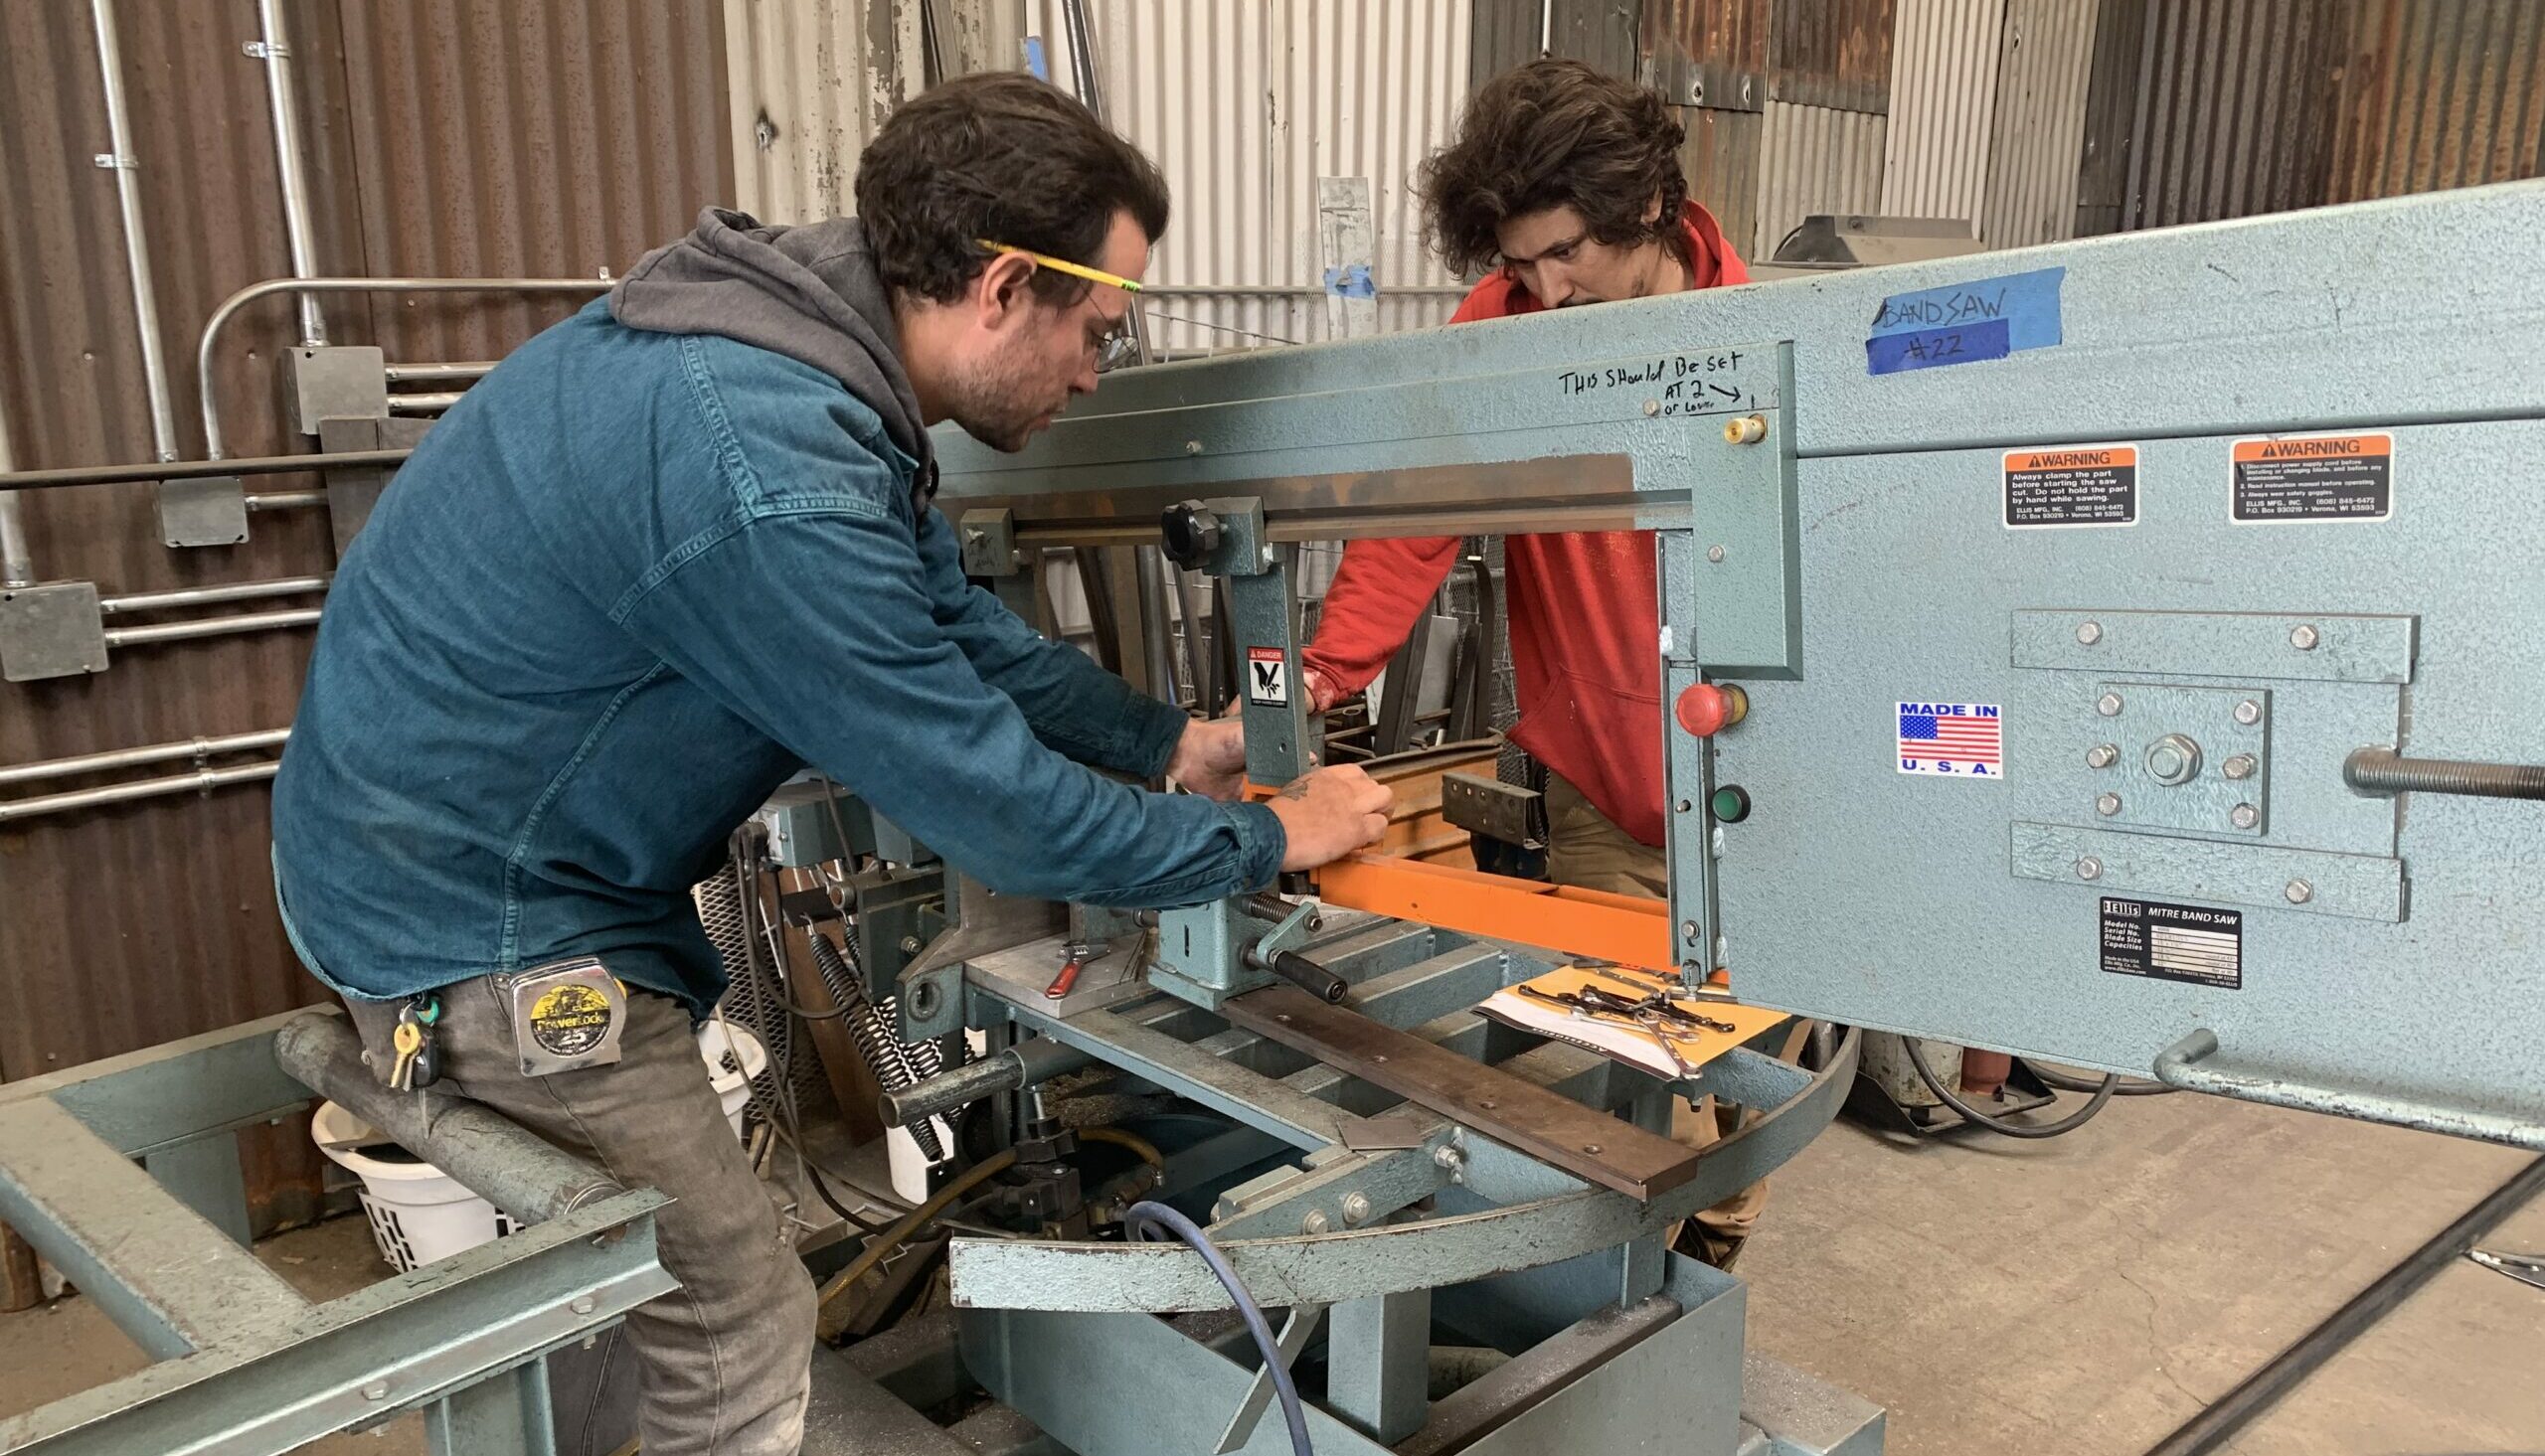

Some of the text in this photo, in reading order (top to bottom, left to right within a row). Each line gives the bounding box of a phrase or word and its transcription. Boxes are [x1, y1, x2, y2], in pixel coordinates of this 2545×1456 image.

[1904, 335, 1964, 361] #22
[1558, 372, 1598, 395] THIS
[1665, 381, 1705, 400] AT 2
[2278, 439, 2361, 456] WARNING
[2041, 451, 2111, 467] WARNING
[2094, 470, 2112, 479] part
[2109, 485, 2127, 494] part
[2076, 494, 2110, 503] sawing.
[1900, 703, 1998, 717] MADE IN
[2113, 902, 2139, 914] Ellis
[2148, 906, 2238, 925] MITRE BAND SAW
[2104, 940, 2143, 951] Capacities
